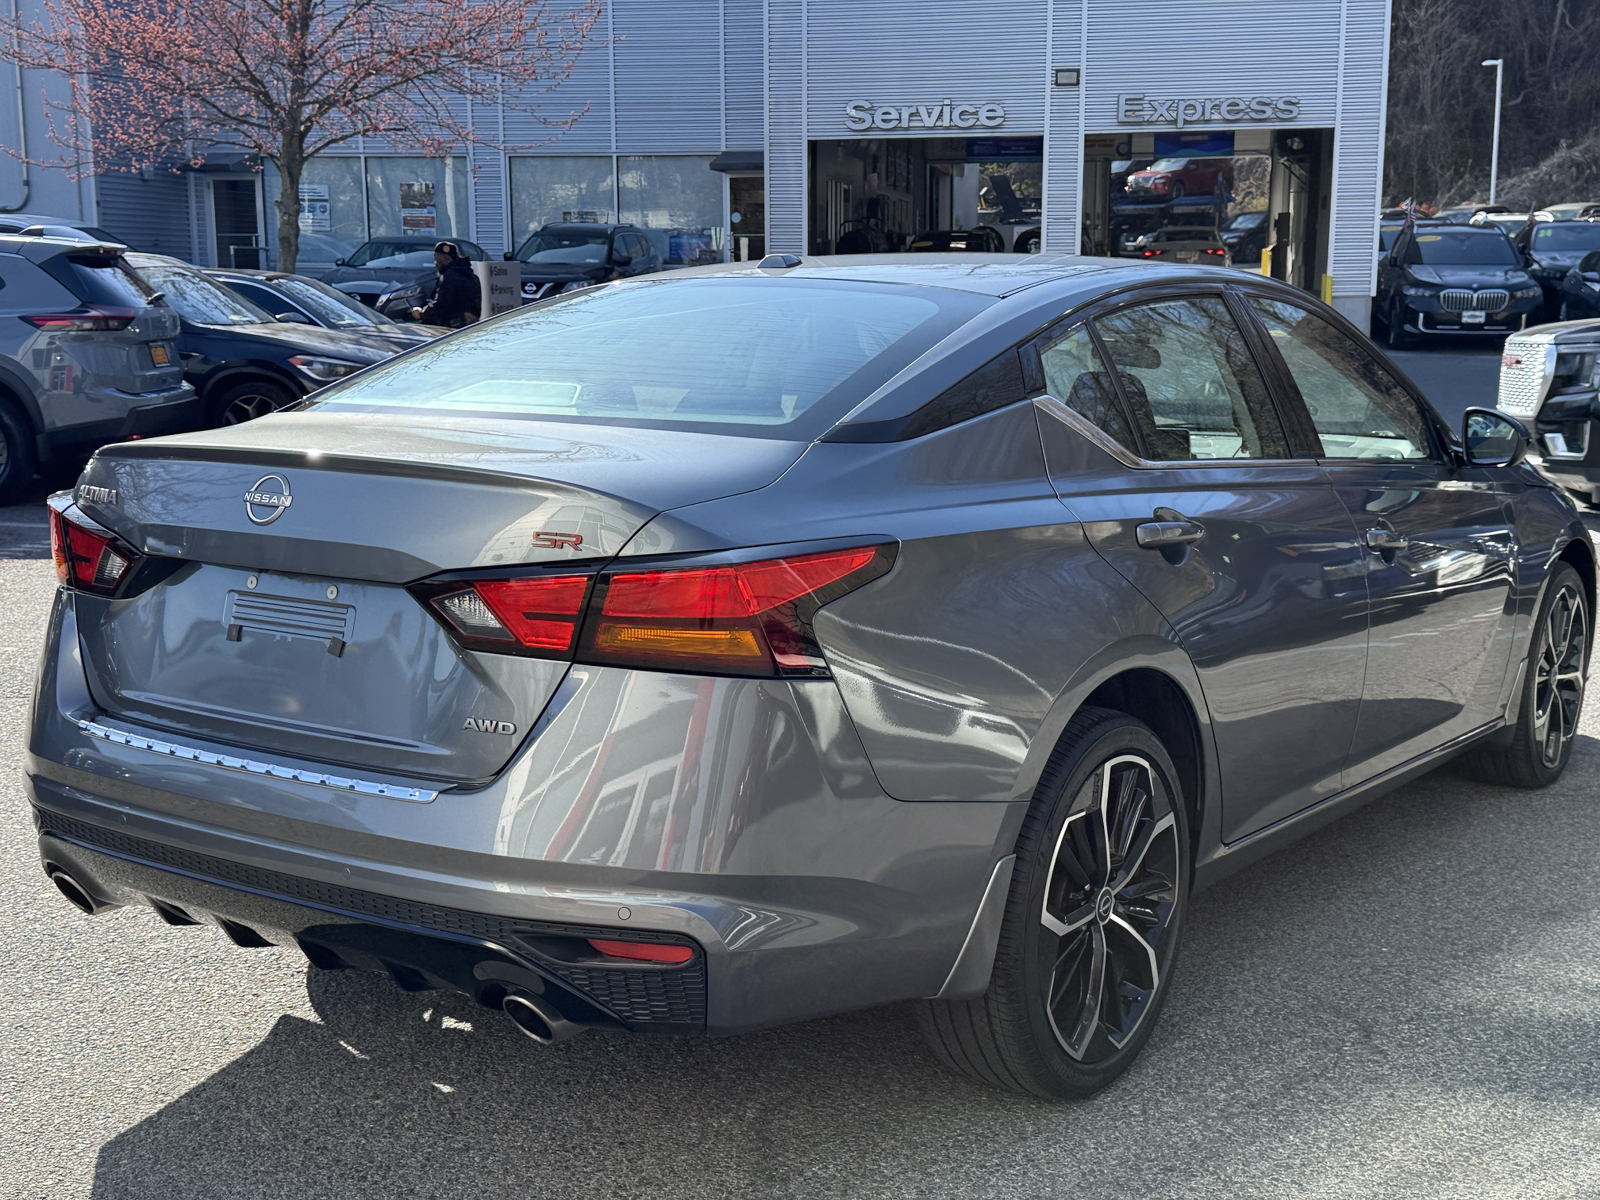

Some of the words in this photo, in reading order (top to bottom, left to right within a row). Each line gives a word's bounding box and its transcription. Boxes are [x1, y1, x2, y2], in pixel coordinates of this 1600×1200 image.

[844, 98, 1006, 131] Service
[1117, 94, 1301, 129] Express
[493, 266, 508, 276] Sales
[495, 285, 514, 296] Parking
[79, 484, 118, 505] ALTIMA
[243, 491, 293, 507] NISSAN
[532, 531, 583, 551] SR
[461, 717, 517, 736] AWD
